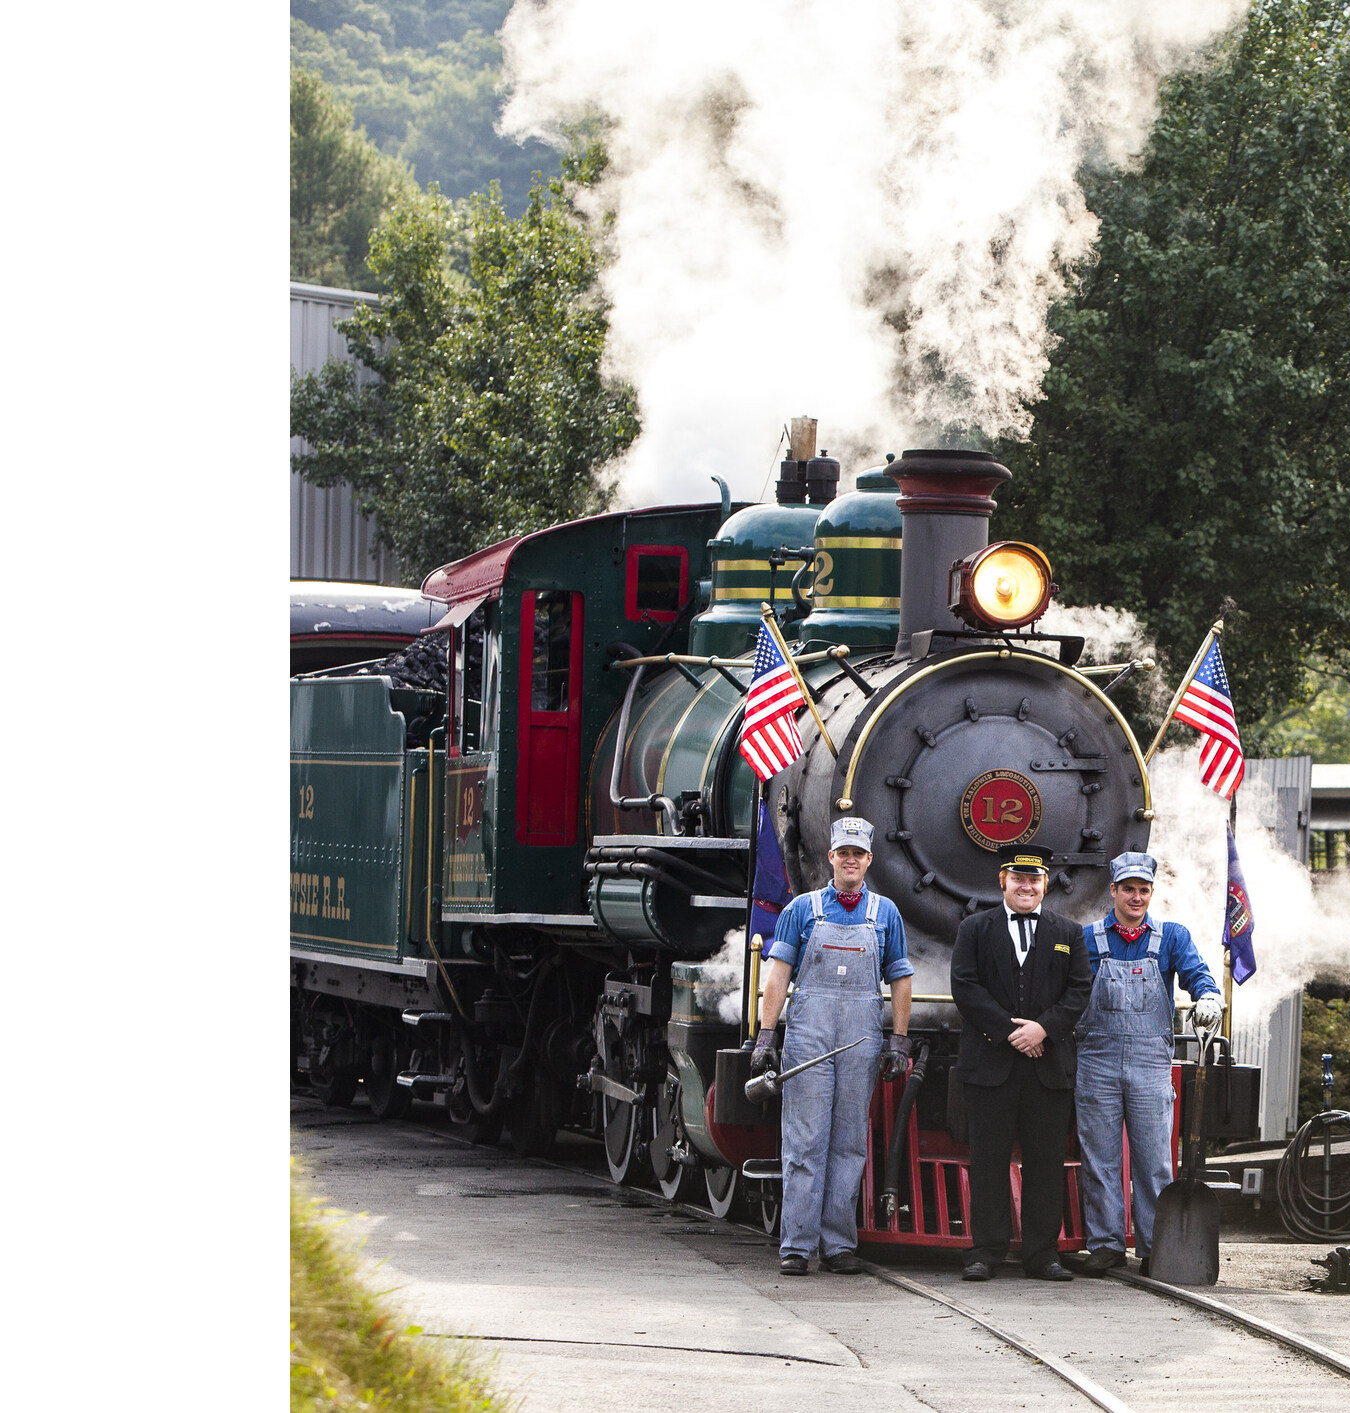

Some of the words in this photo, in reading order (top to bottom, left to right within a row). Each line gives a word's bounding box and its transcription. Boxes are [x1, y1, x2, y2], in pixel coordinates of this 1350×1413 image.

[298, 784, 315, 820] 12
[462, 786, 475, 826] 12
[965, 773, 993, 800] BALDWIN
[995, 770, 1034, 796] LOCOMOTIVE
[1032, 794, 1041, 821] WORKS
[980, 797, 1024, 825] 12
[1018, 827, 1037, 844] U.S.A.
[290, 871, 320, 917] TSIE
[321, 875, 351, 921] R.R.
